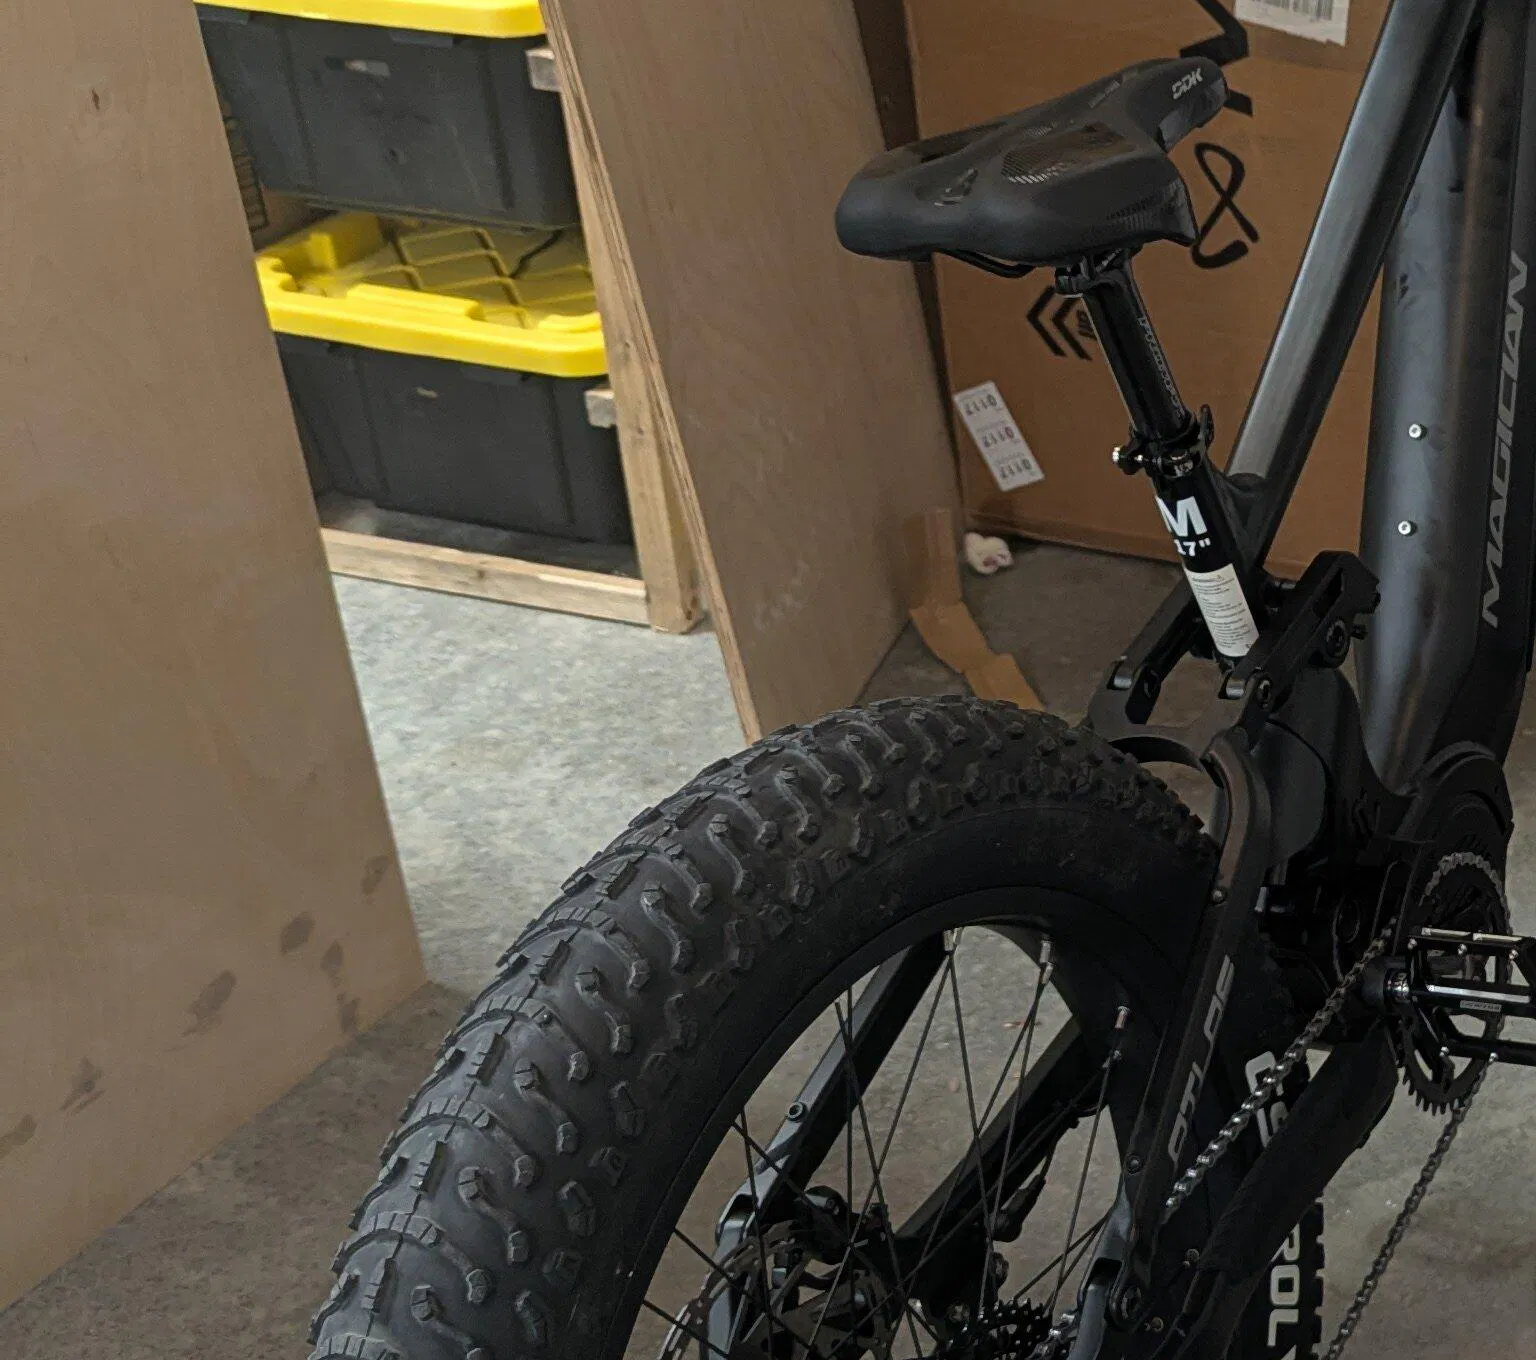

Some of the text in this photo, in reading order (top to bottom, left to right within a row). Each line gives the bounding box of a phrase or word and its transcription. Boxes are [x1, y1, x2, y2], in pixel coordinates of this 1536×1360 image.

[1482, 250, 1529, 629] MAGICIAN
[1155, 496, 1208, 537] M
[1174, 537, 1211, 557] 17"
